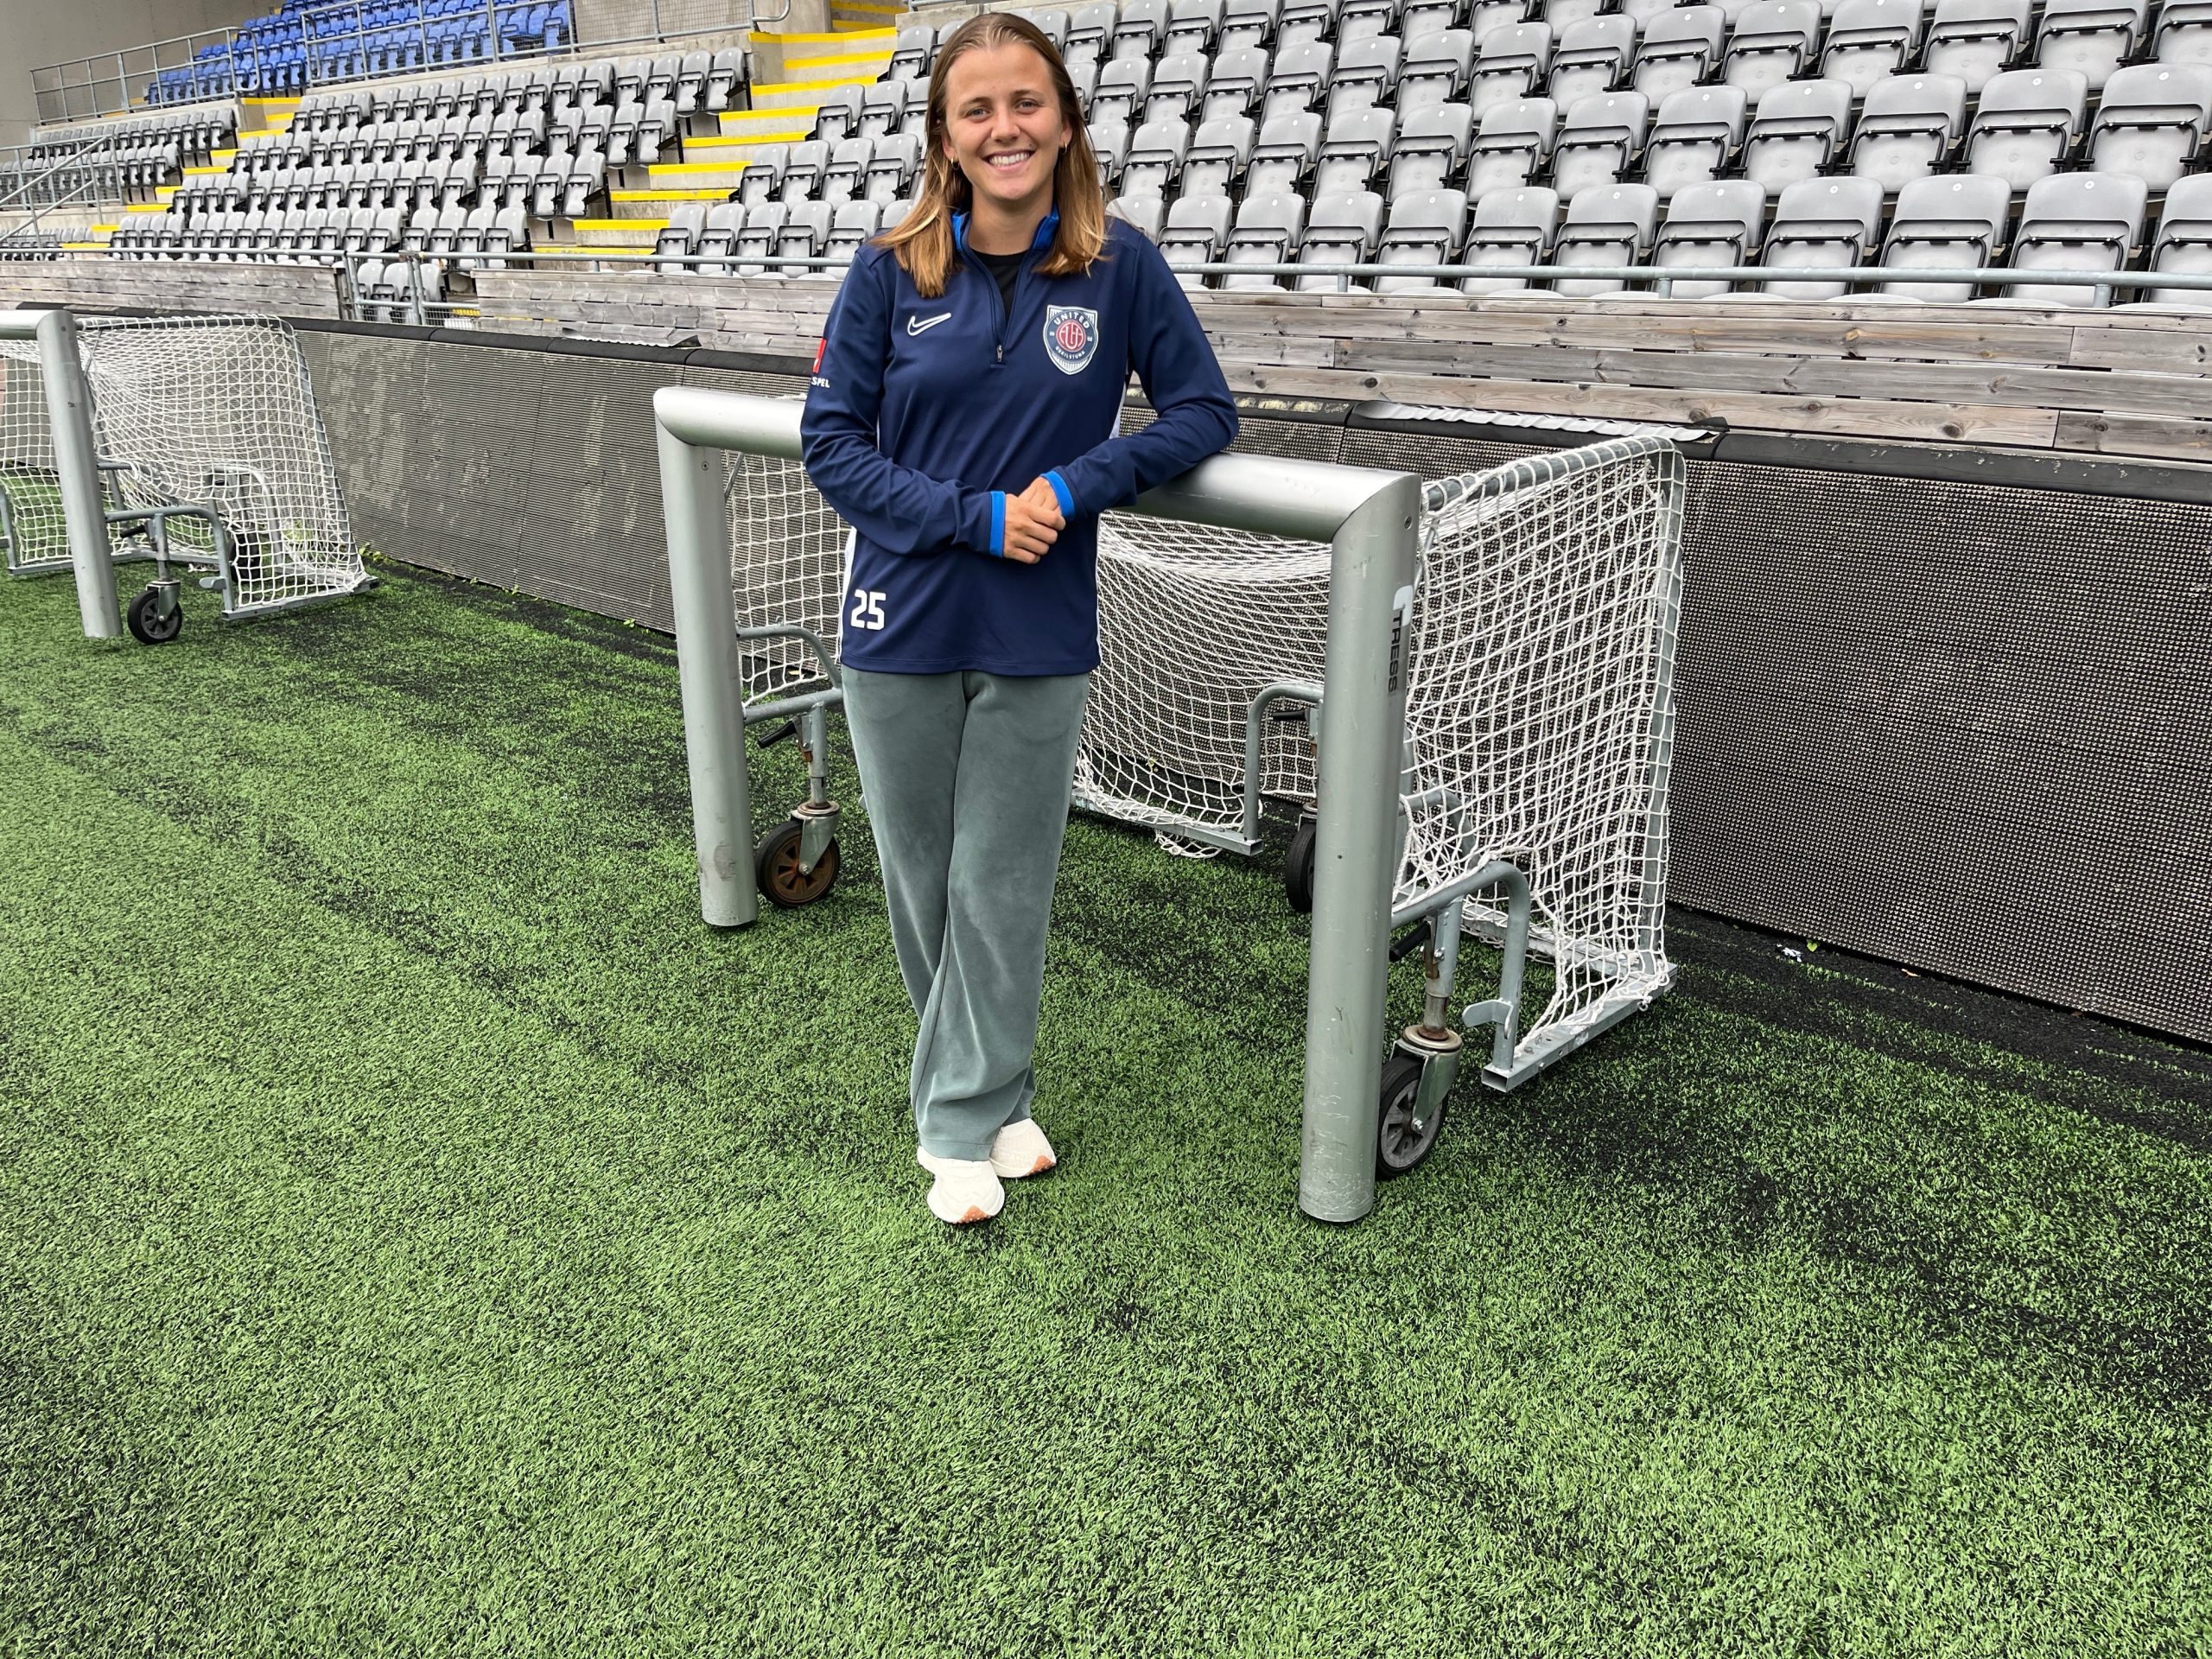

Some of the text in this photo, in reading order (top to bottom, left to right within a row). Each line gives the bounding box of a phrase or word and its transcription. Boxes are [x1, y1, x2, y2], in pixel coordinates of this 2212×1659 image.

[1053, 311, 1090, 328] UNITED
[810, 376, 830, 389] SPEL
[850, 588, 887, 631] 25
[1388, 610, 1403, 693] TRESS
